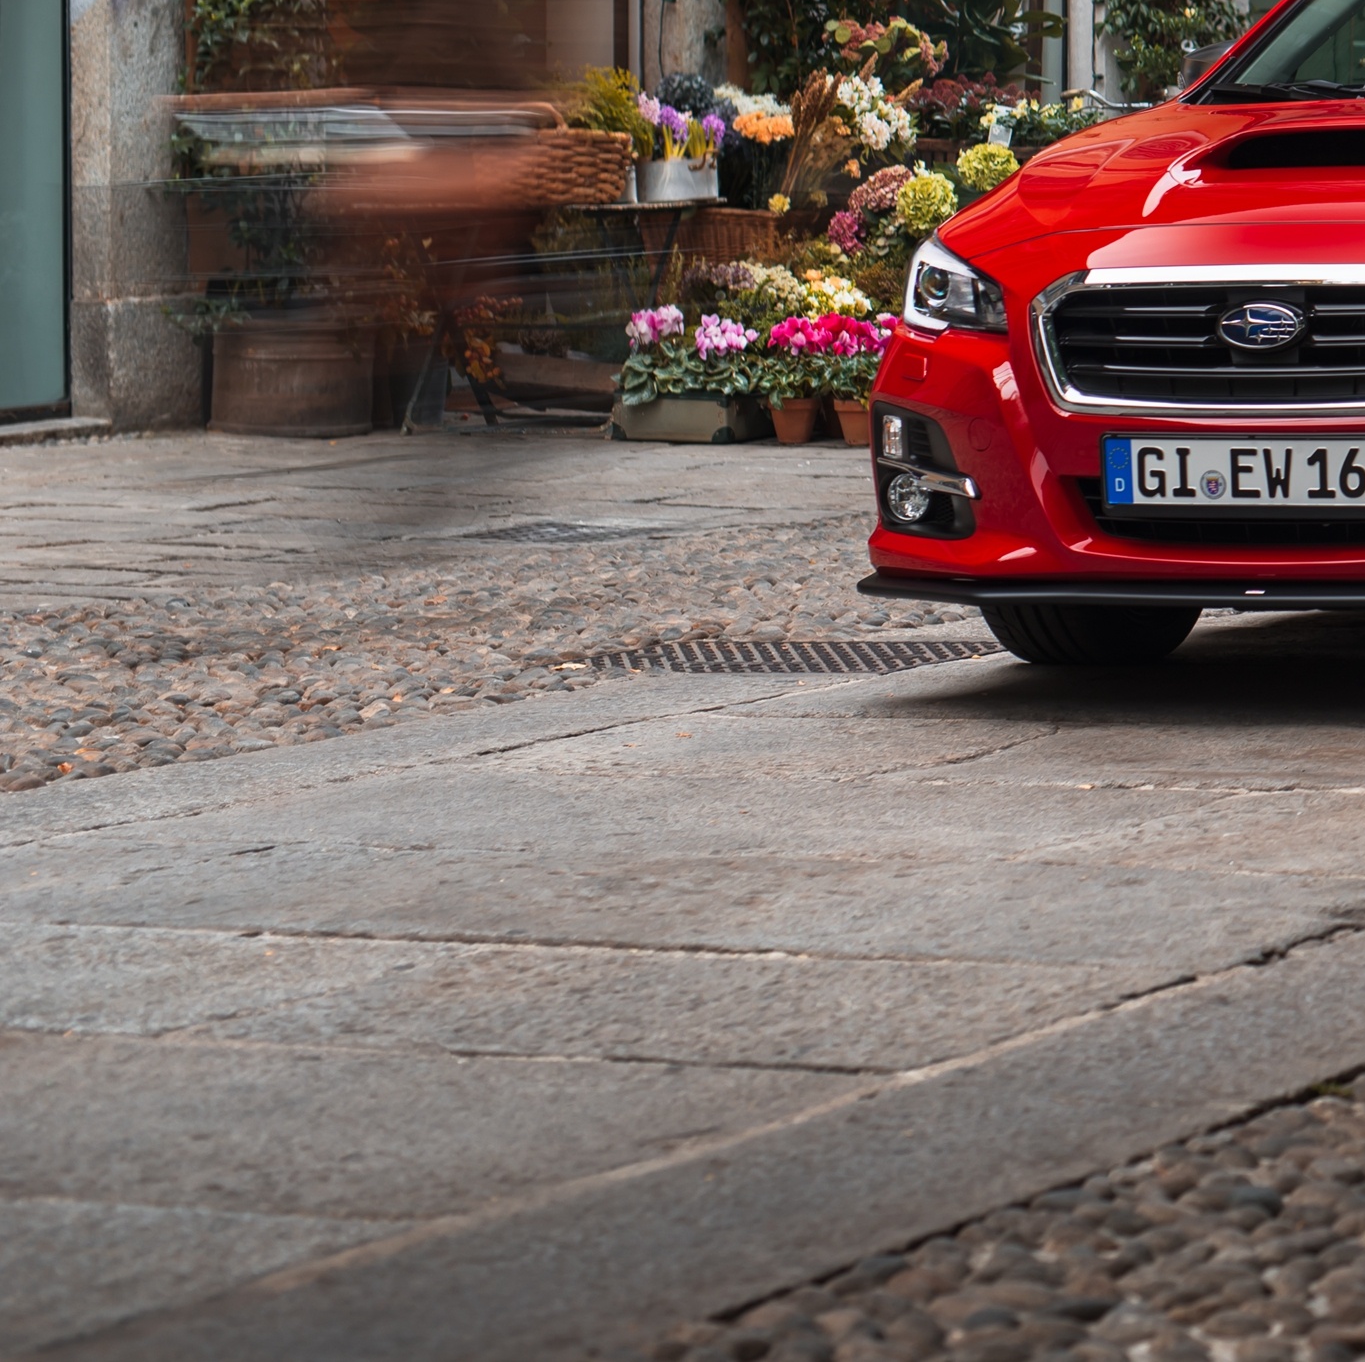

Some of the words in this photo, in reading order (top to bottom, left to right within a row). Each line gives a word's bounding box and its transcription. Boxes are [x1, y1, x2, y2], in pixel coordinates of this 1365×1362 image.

[1115, 477, 1125, 492] D
[1137, 446, 1196, 498] GI
[1230, 447, 1292, 498] EW
